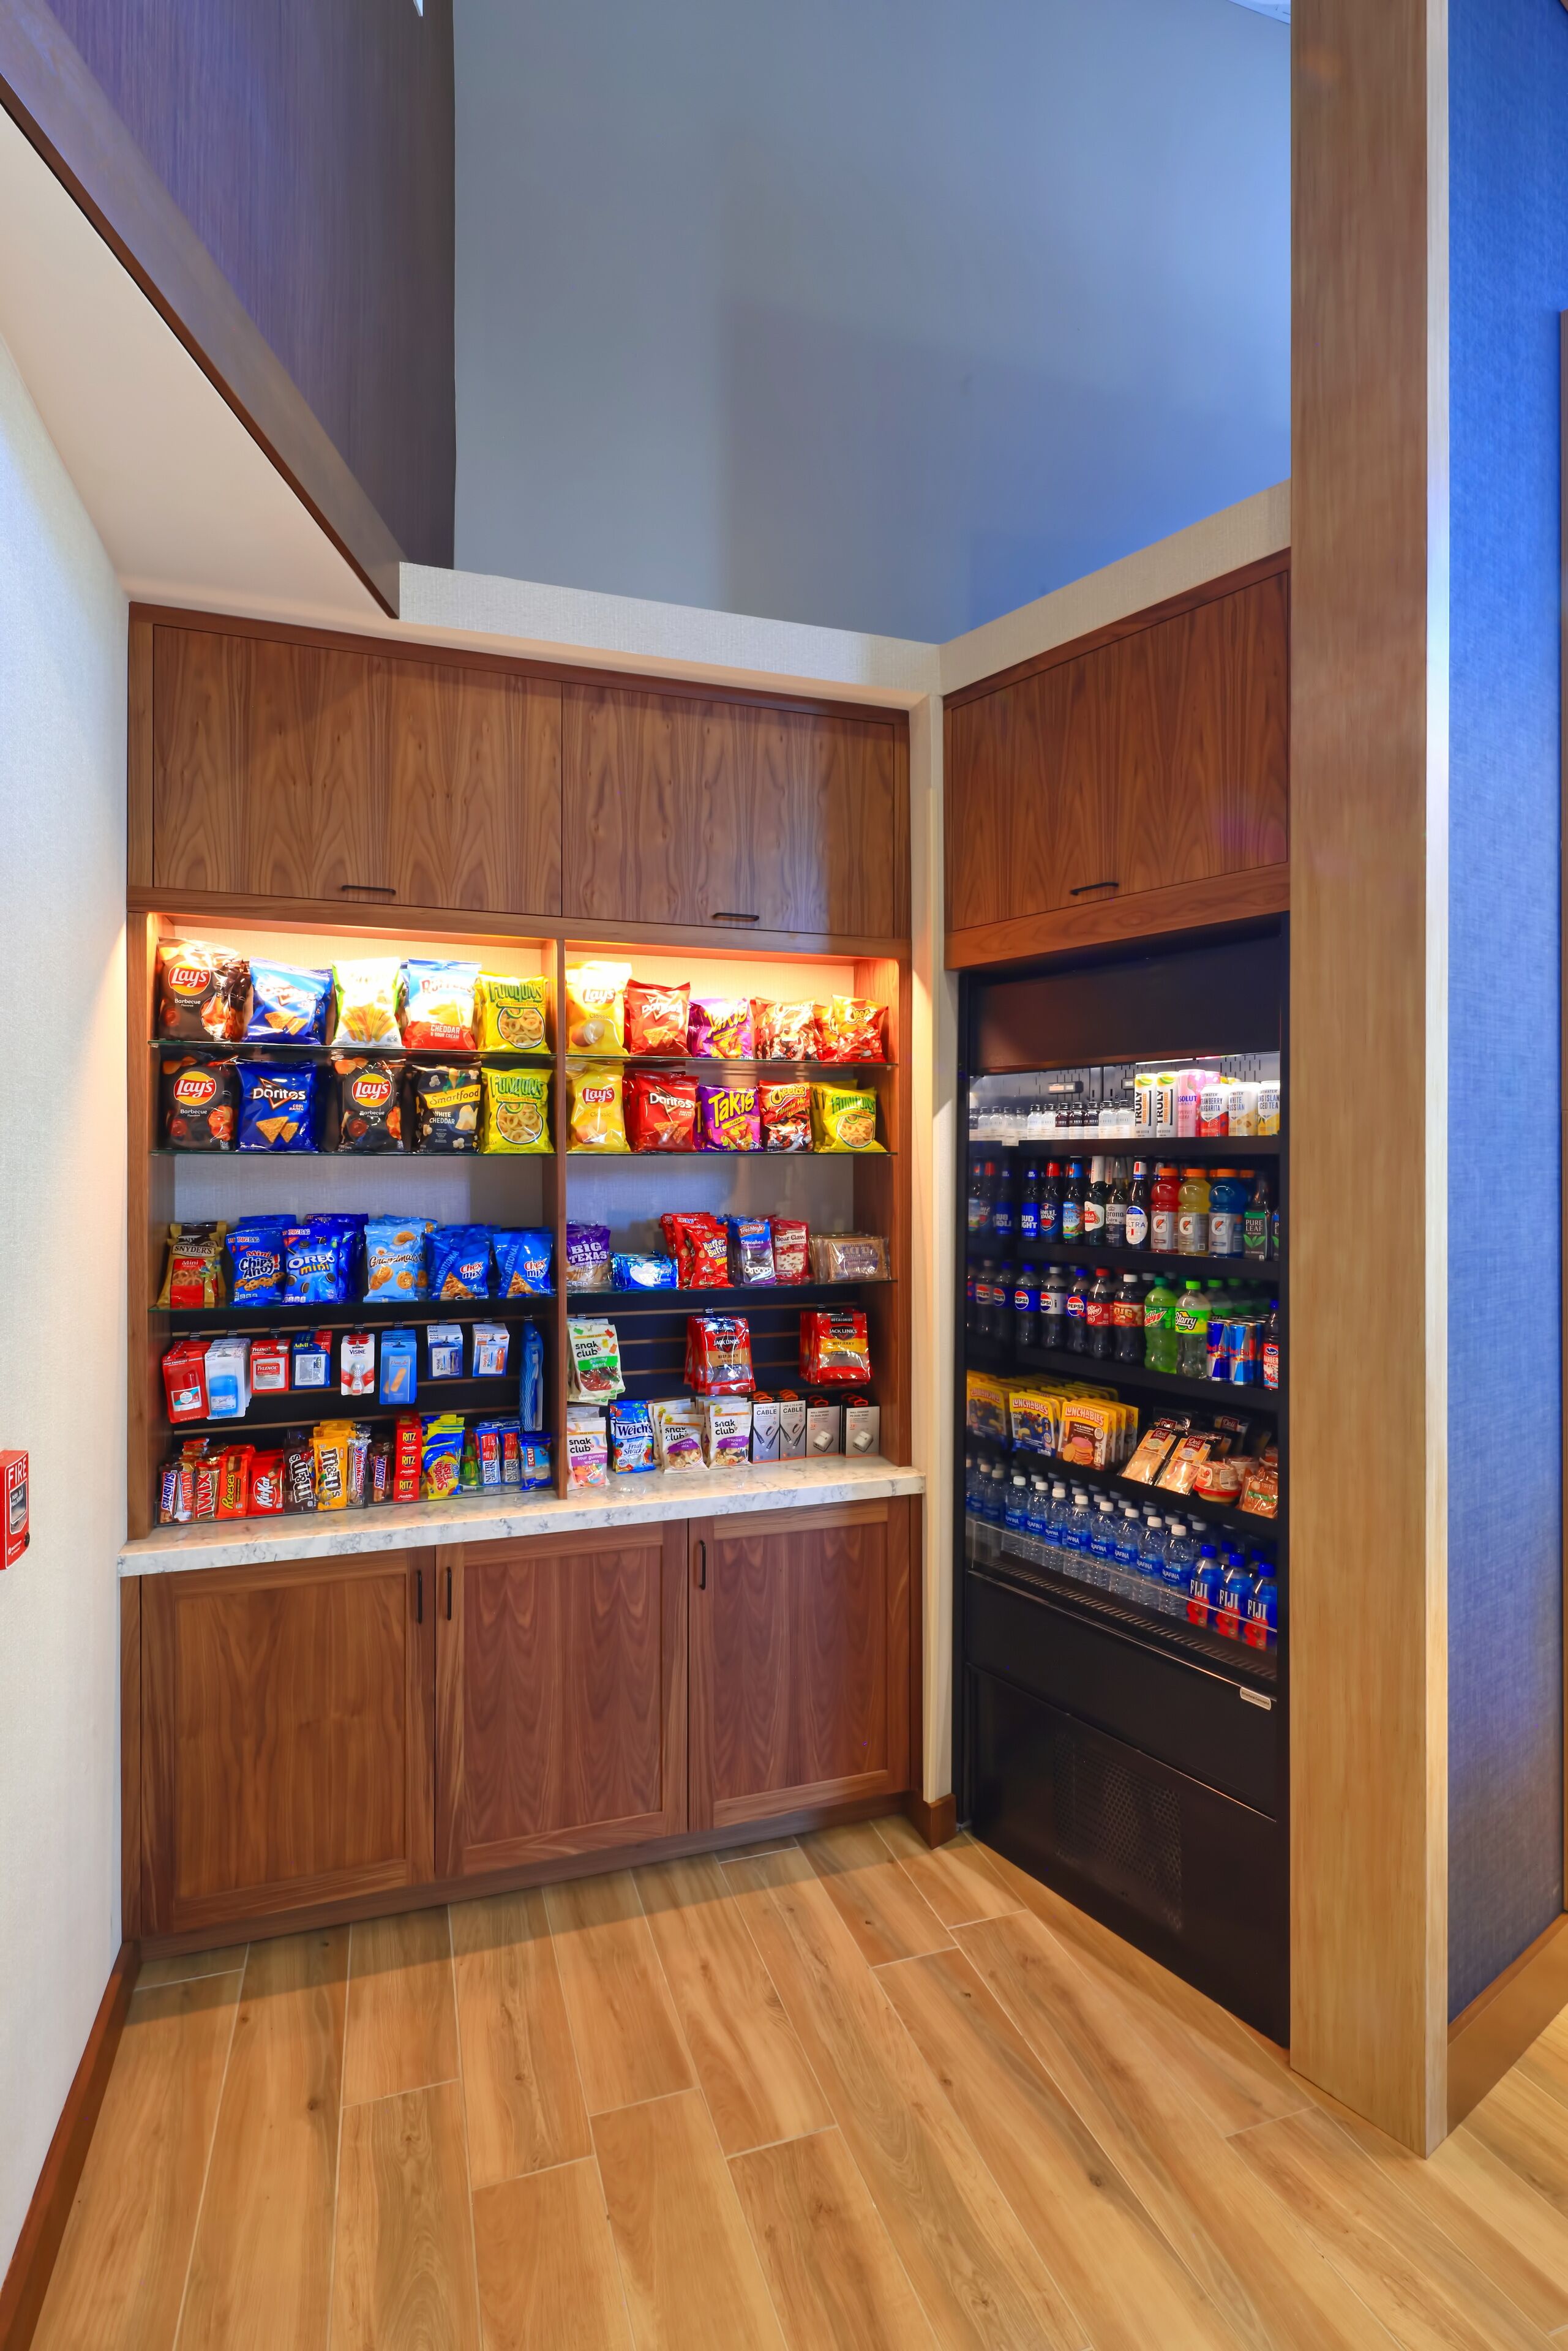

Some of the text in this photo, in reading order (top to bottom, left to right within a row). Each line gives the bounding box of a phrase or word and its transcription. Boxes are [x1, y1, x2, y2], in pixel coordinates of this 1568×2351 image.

[171, 968, 208, 988] Lay's
[430, 1024, 460, 1034] CHEDDAR
[176, 1079, 214, 1098] Lay's
[253, 1087, 306, 1100] Doritos
[356, 1081, 389, 1100] Lay's
[583, 1088, 613, 1104] Lay's
[770, 1085, 806, 1104] Cheetos
[429, 1088, 479, 1106] Smartfood
[650, 1093, 695, 1109] Doritos
[708, 1090, 754, 1128] Takis
[174, 1245, 212, 1254] SNYDER'S
[703, 1239, 725, 1251] Nutter
[707, 1245, 727, 1258] Butter
[239, 1256, 273, 1271] Chips
[288, 1254, 335, 1269] OREO
[524, 1258, 547, 1271] Chex
[569, 1250, 607, 1264] TEXAS
[299, 1262, 330, 1275] mini
[435, 1250, 459, 1286] TRADITIONAL
[460, 1261, 484, 1273] Chex
[462, 1269, 482, 1280] mix
[527, 1267, 546, 1278] mix
[1176, 1310, 1196, 1329] Starry
[576, 1341, 599, 1350] snak
[577, 1348, 598, 1359] club
[1013, 1398, 1048, 1415] LUNCHABLES
[715, 1419, 735, 1428] snak
[1065, 1406, 1104, 1426] LUNCHABLES
[403, 1432, 416, 1442] RITZ
[617, 1423, 653, 1436] Welch's
[570, 1444, 591, 1453] club
[402, 1455, 416, 1465] RITZ
[9, 1457, 27, 1489] FIRE
[375, 1455, 387, 1489] SATISFIES
[433, 1460, 448, 1491] Swedish
[441, 1463, 453, 1482] Fish
[162, 1472, 175, 1510] SATISFIES
[221, 1471, 235, 1509] Reese's
[399, 1480, 413, 1490] RITZ
[197, 1472, 214, 1517] TWIX
[1027, 1520, 1043, 1530] QUAFINA
[1090, 1542, 1106, 1552] QUAFINA
[1163, 1569, 1180, 1581] QUAFINA
[1190, 1578, 1208, 1598] FIJI
[1220, 1589, 1239, 1610] FIJI
[1248, 1600, 1267, 1621] FIJI
